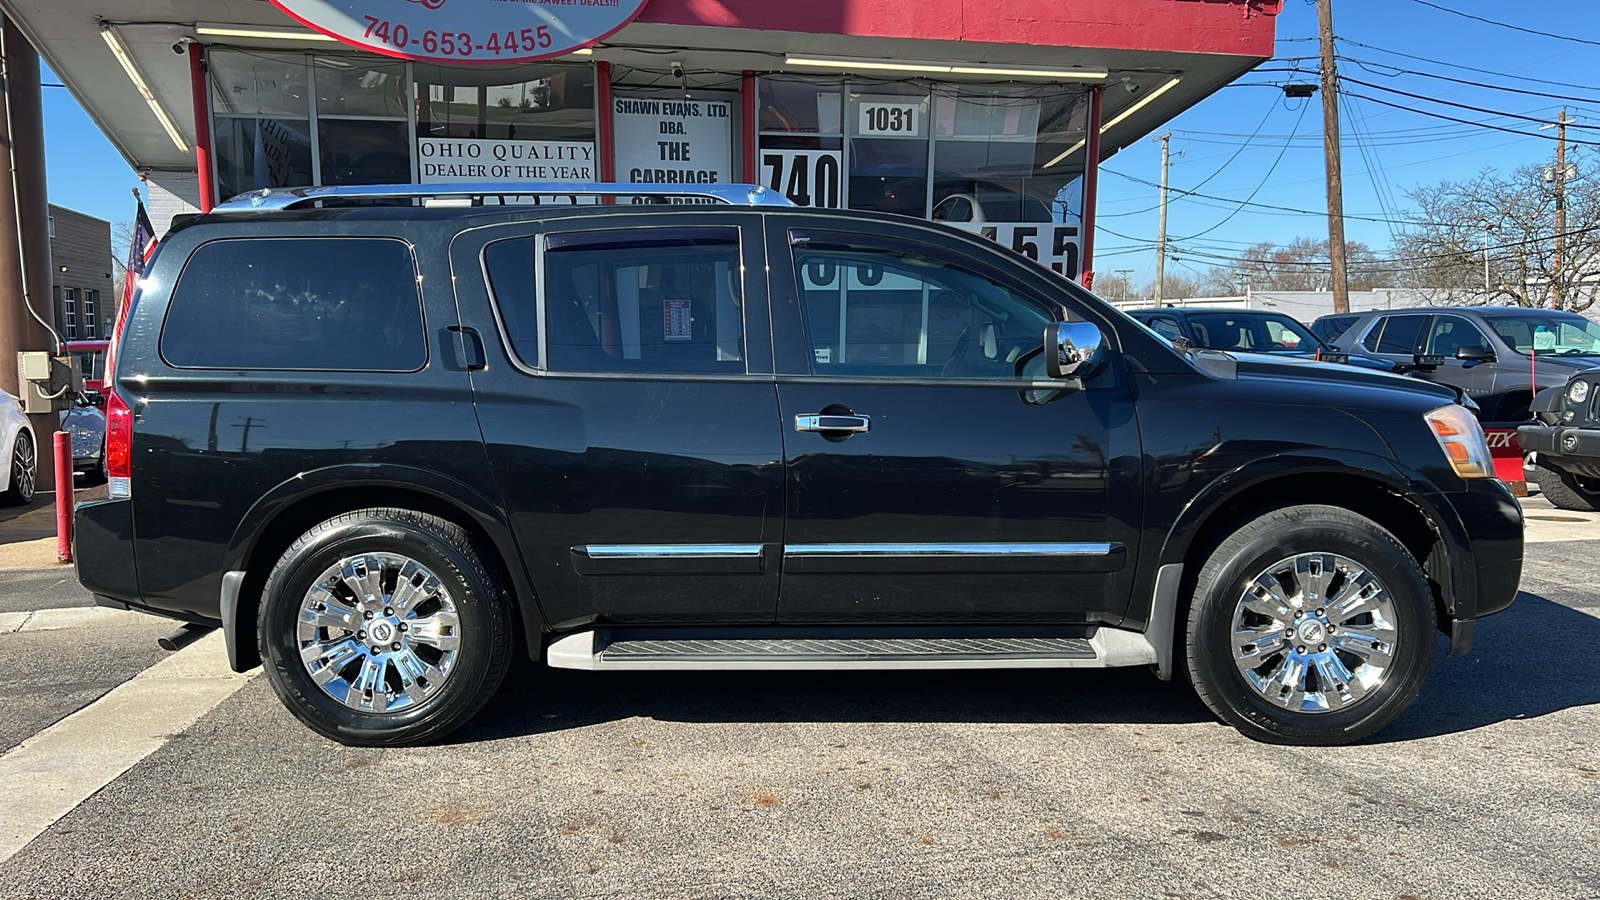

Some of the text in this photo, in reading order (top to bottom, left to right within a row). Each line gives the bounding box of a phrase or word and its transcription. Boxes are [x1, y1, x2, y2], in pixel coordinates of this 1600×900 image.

[363, 15, 552, 56] 740-653-4455
[616, 100, 660, 115] SHAWN
[707, 104, 730, 118] LTD.
[659, 121, 688, 135] DBA.
[865, 107, 914, 132] 1031
[421, 142, 594, 161] OHIO QUALITY
[657, 141, 691, 161] THE
[424, 163, 592, 179] DEALER OF THE YEAR
[763, 154, 839, 208] 740
